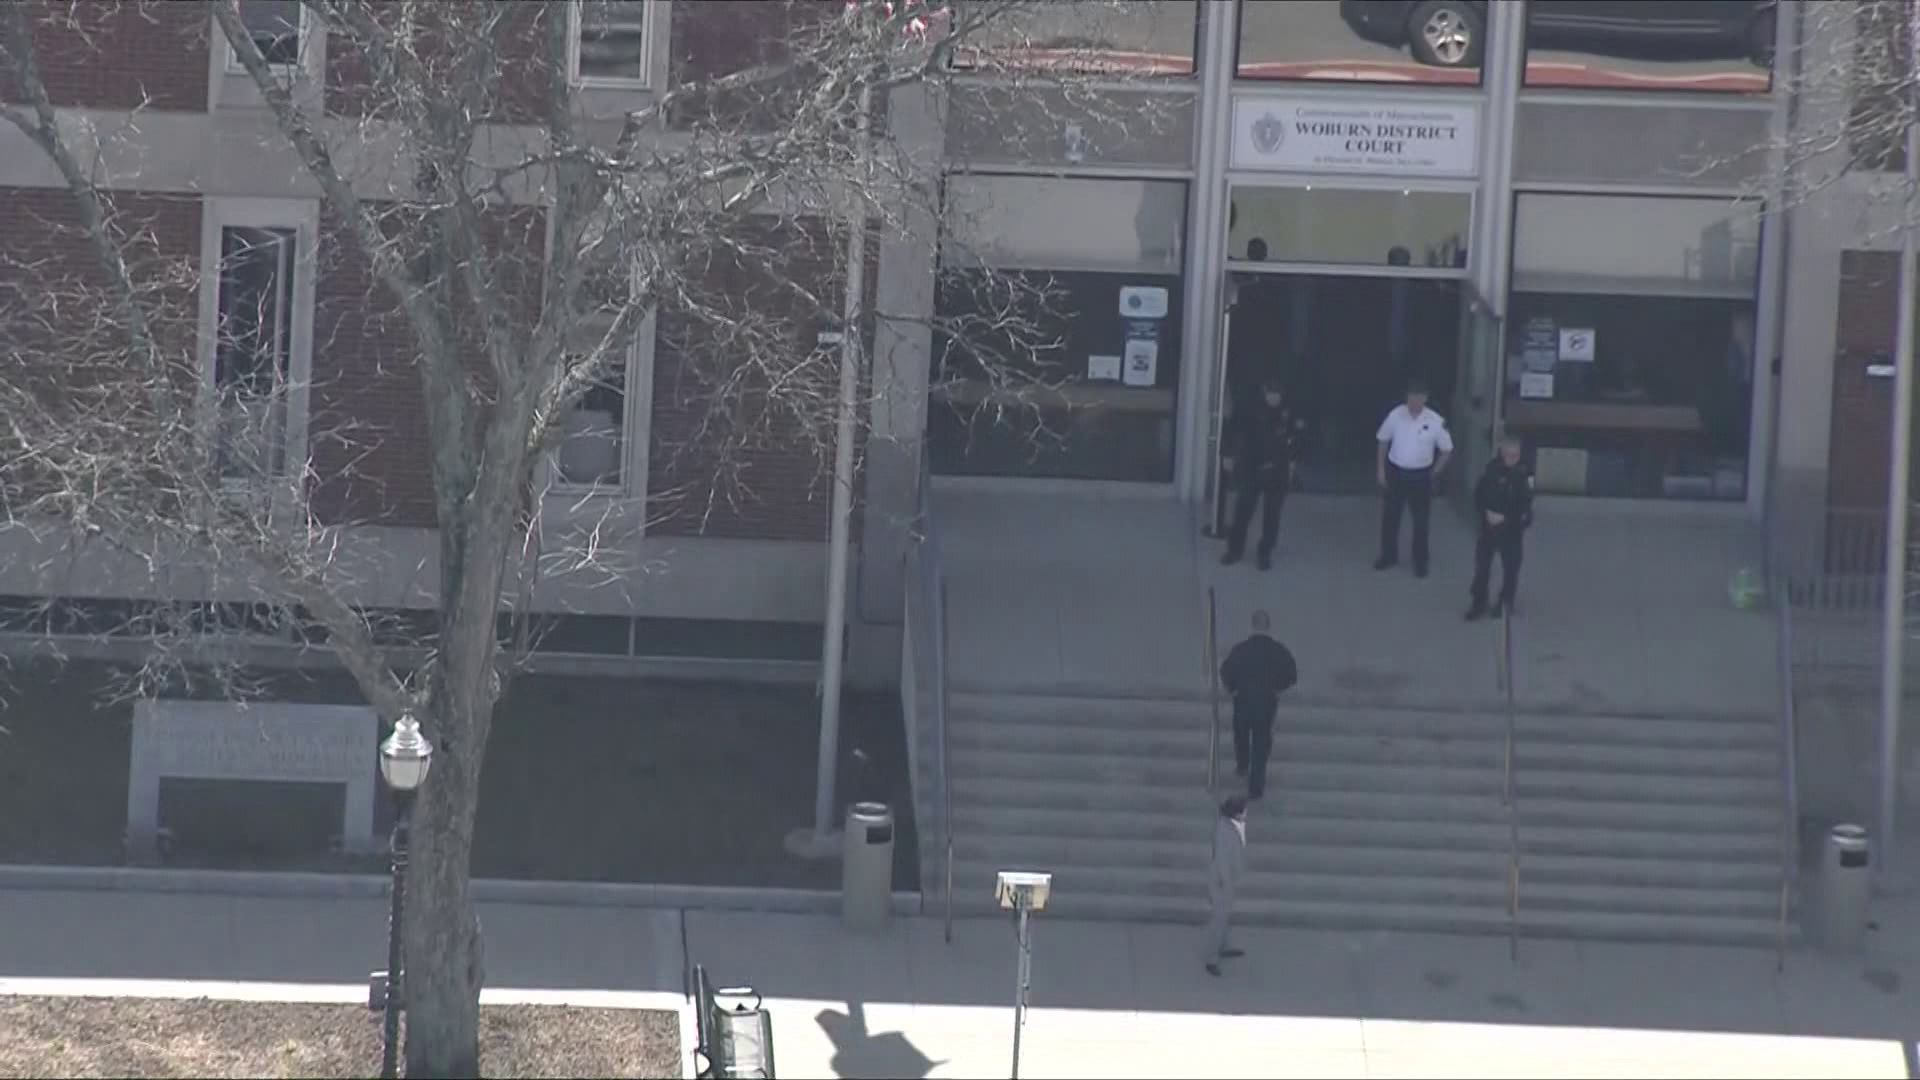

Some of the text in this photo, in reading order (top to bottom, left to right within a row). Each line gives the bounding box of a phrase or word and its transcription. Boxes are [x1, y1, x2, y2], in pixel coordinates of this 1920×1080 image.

[1296, 121, 1457, 139] WOBURN DISTRICT
[1345, 139, 1405, 153] COURT
